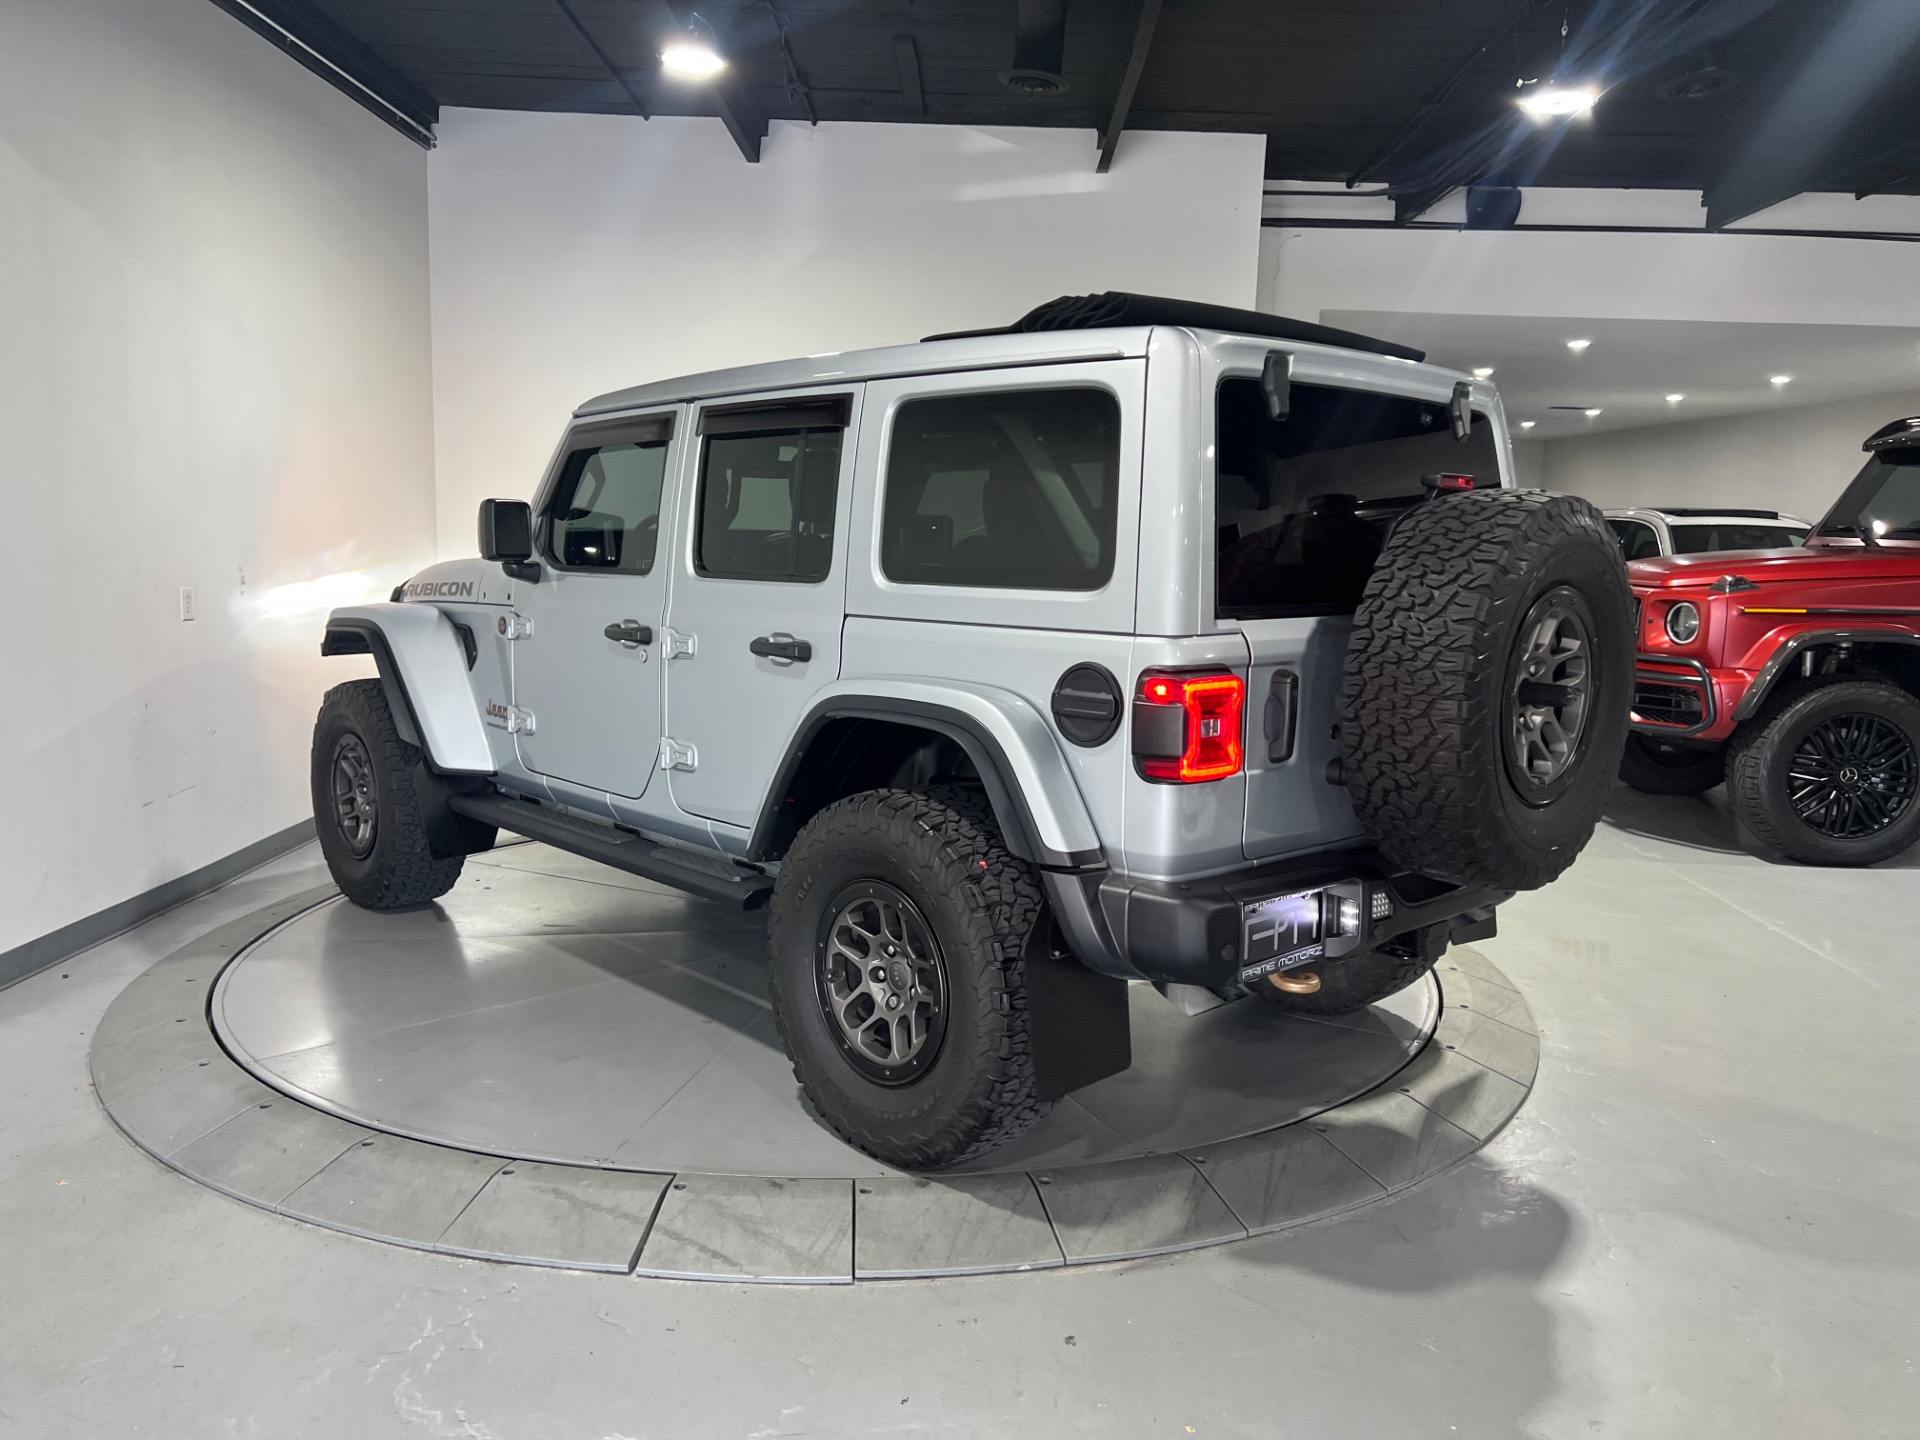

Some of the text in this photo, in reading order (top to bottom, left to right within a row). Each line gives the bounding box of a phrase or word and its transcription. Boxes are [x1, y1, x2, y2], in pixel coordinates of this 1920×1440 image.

[406, 582, 474, 597] RUBICON
[1242, 946, 1323, 980] PRIME MOTORZ
